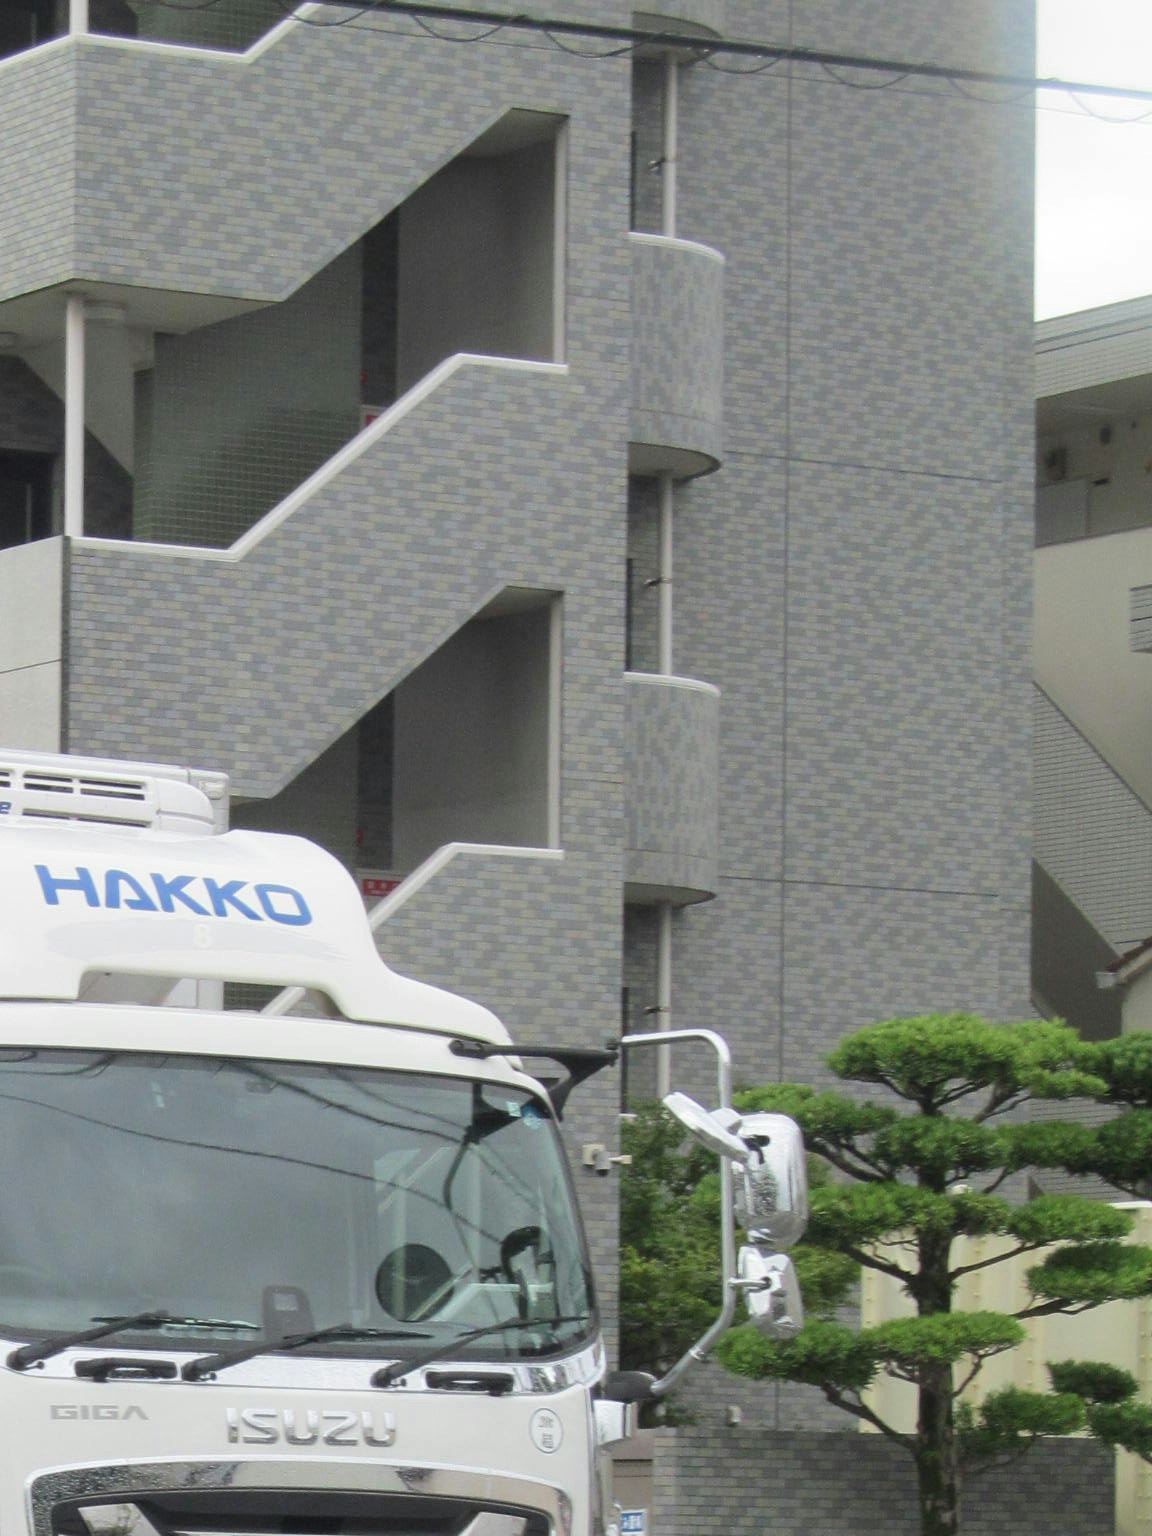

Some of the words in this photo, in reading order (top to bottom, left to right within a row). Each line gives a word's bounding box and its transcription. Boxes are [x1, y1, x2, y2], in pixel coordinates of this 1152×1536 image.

[34, 865, 313, 926] HAKKO
[50, 1405, 148, 1420] GIGA
[227, 1408, 396, 1447] ISUZU
